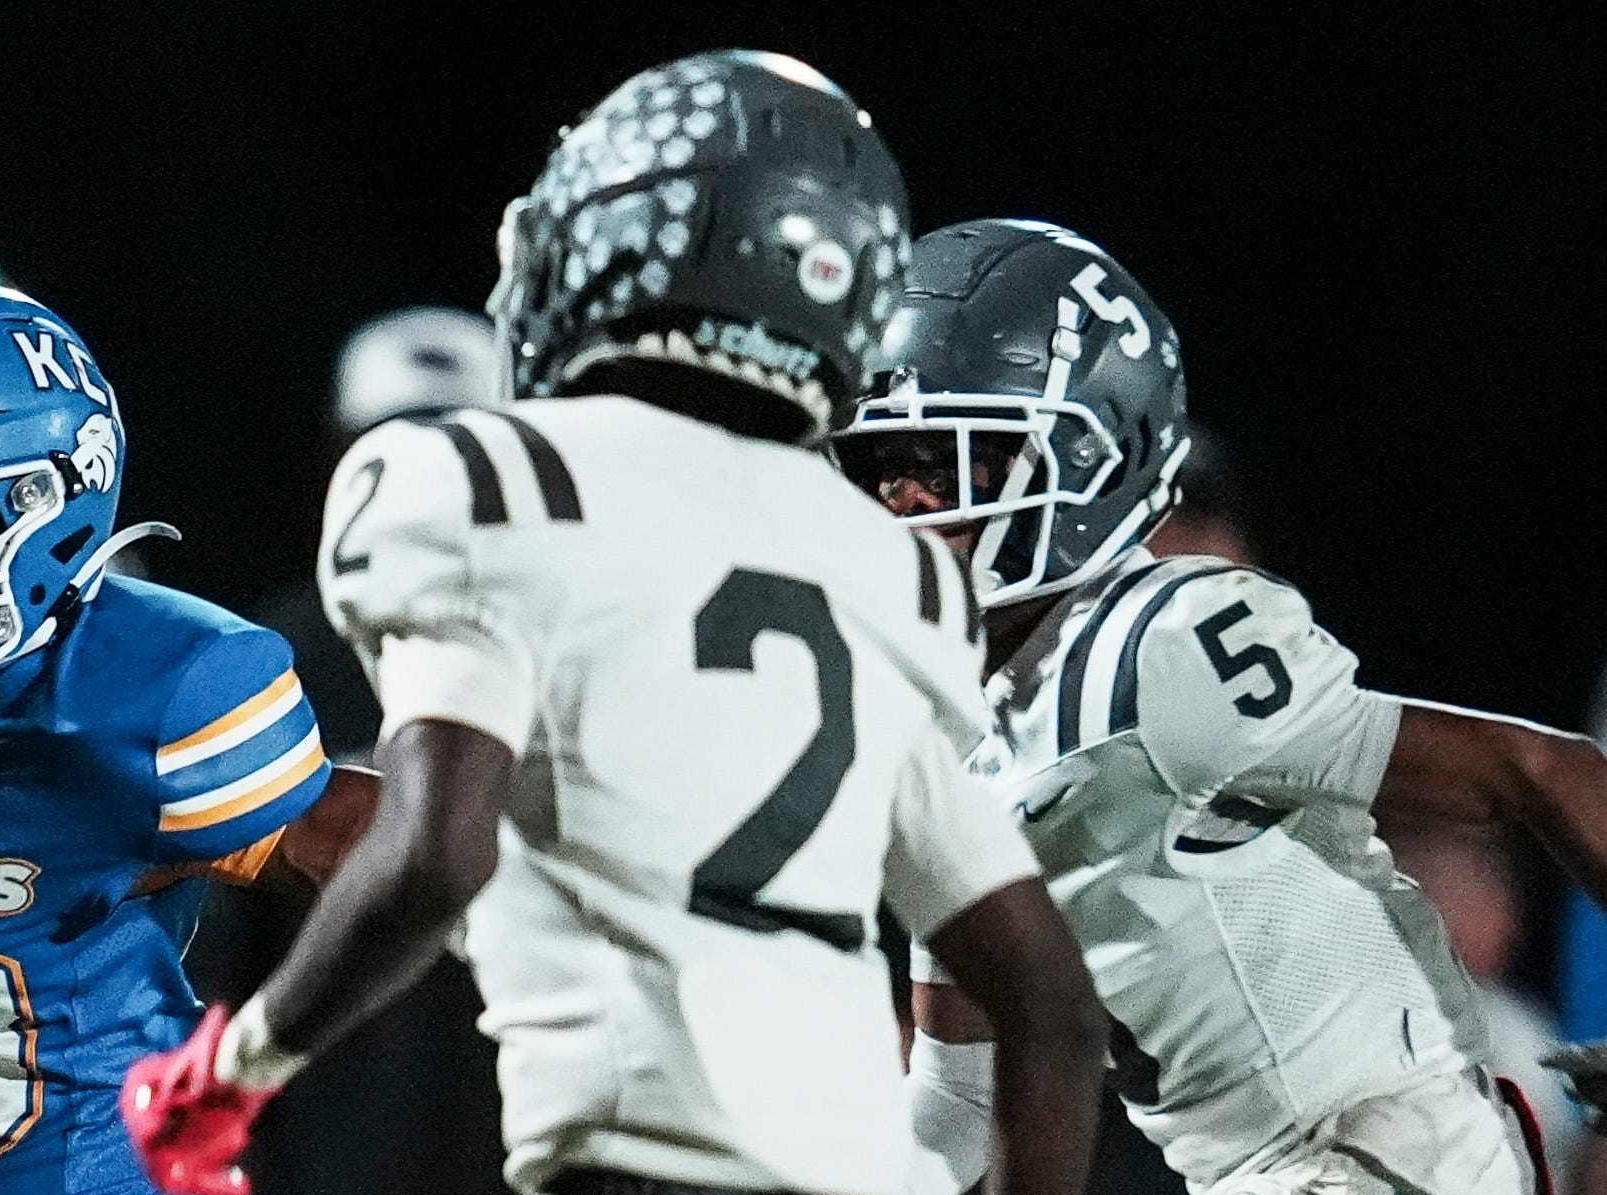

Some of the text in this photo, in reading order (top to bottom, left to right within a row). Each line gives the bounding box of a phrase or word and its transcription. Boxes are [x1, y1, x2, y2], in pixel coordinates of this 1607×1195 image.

[1069, 262, 1152, 360] 5
[332, 458, 386, 577] 2
[1193, 599, 1294, 720] 5
[688, 564, 866, 954] 2
